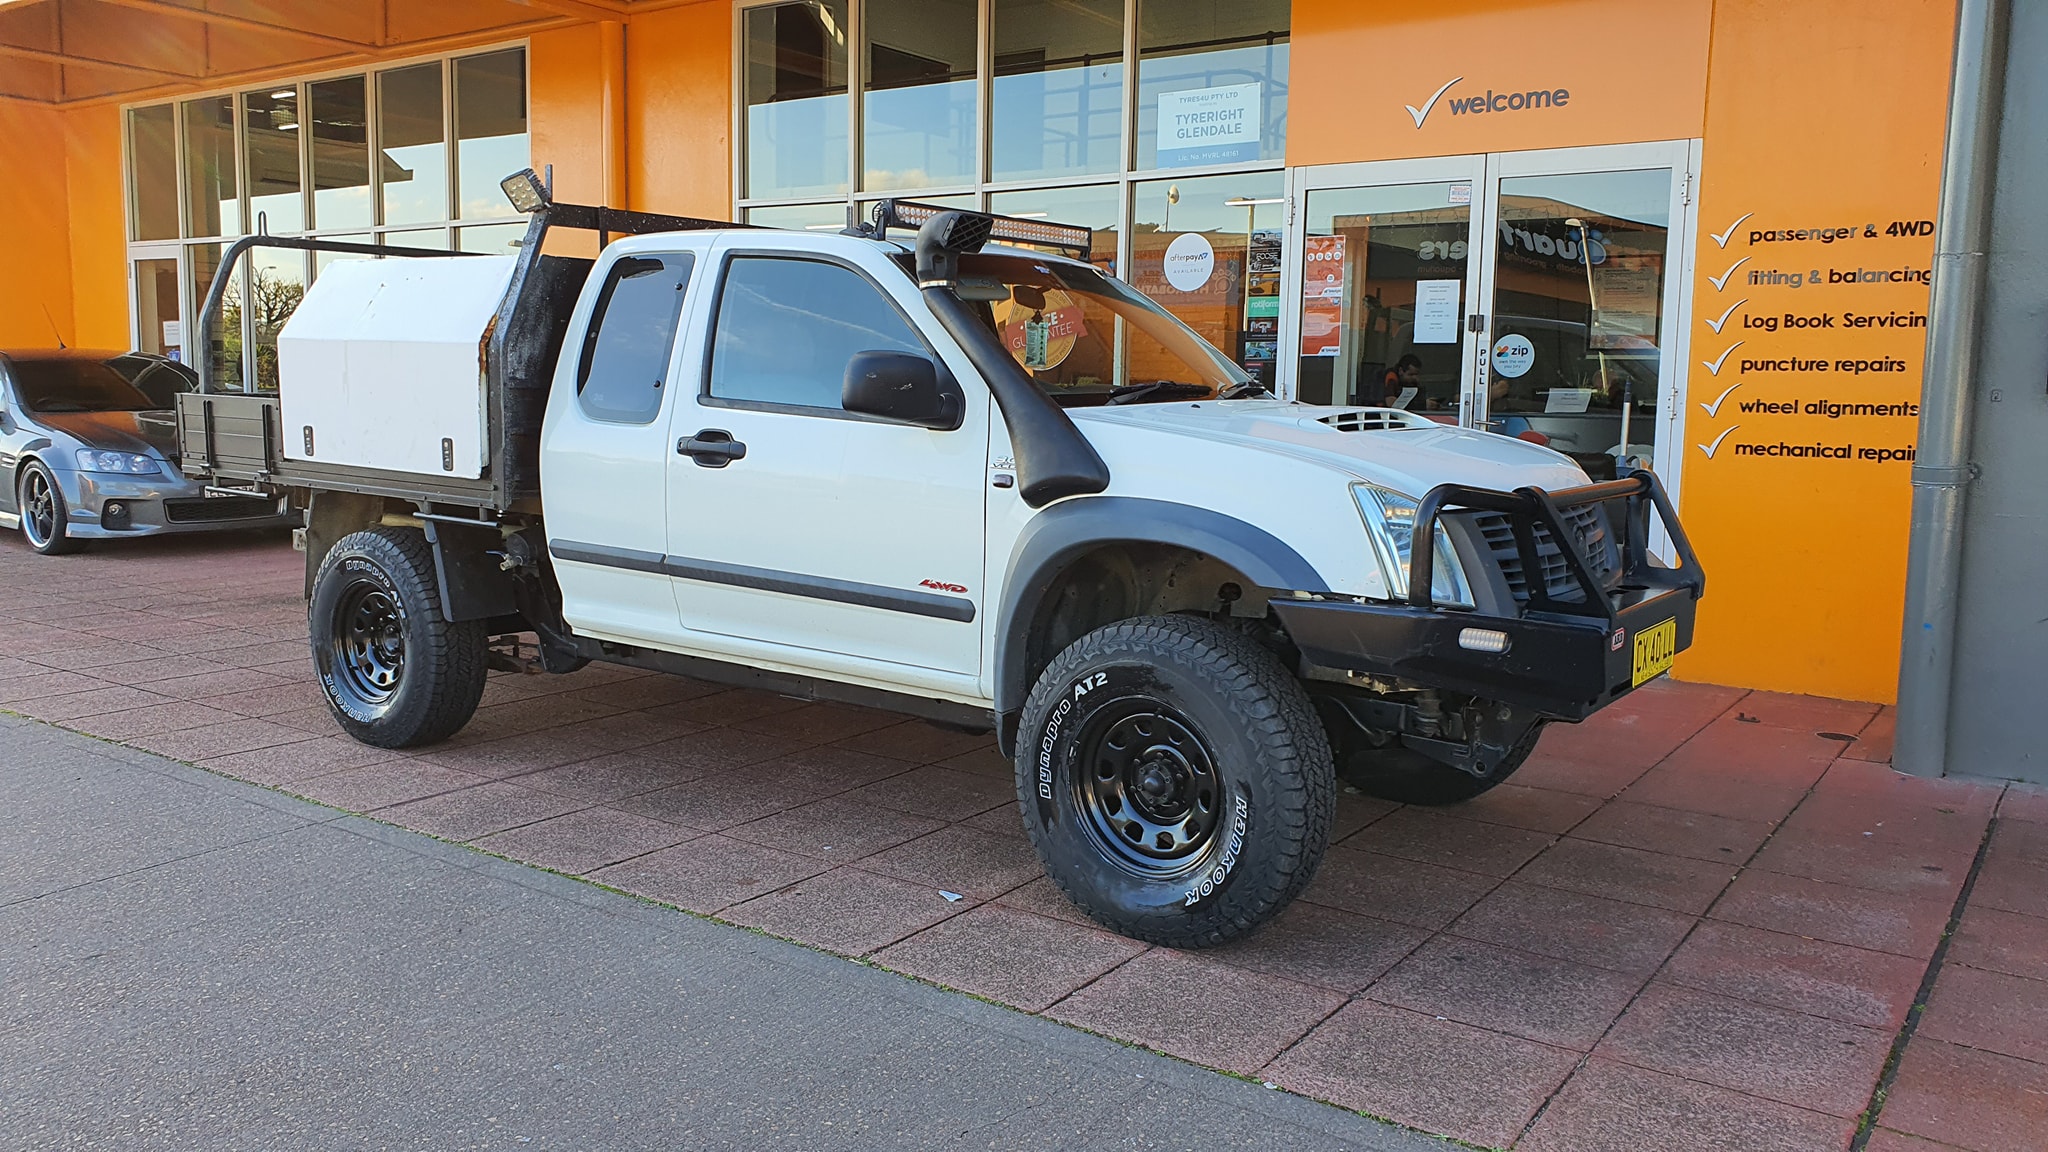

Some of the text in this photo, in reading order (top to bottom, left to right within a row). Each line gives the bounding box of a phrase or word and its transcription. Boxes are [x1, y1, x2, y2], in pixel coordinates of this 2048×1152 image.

[1179, 95, 1210, 104] TYRES4U
[1225, 91, 1239, 99] LTD
[1448, 89, 1570, 115] welcome
[1175, 108, 1244, 125] TYRERIGHT
[1176, 123, 1242, 139] GLENDALE
[1749, 220, 1935, 246] passenger & 4WD
[1170, 253, 1199, 263] afterpay
[1747, 266, 1932, 288] fitting & balancing
[1743, 311, 1927, 331] Log Book Servicin
[1511, 345, 1529, 358] zip
[1479, 348, 1487, 385] PULL
[1740, 356, 1906, 375] puncture repairs
[1739, 399, 1919, 418] wheel alignments
[1735, 443, 1852, 459] mechanical
[918, 579, 968, 593] 4WD
[1039, 671, 1108, 800] Dynapro AT2
